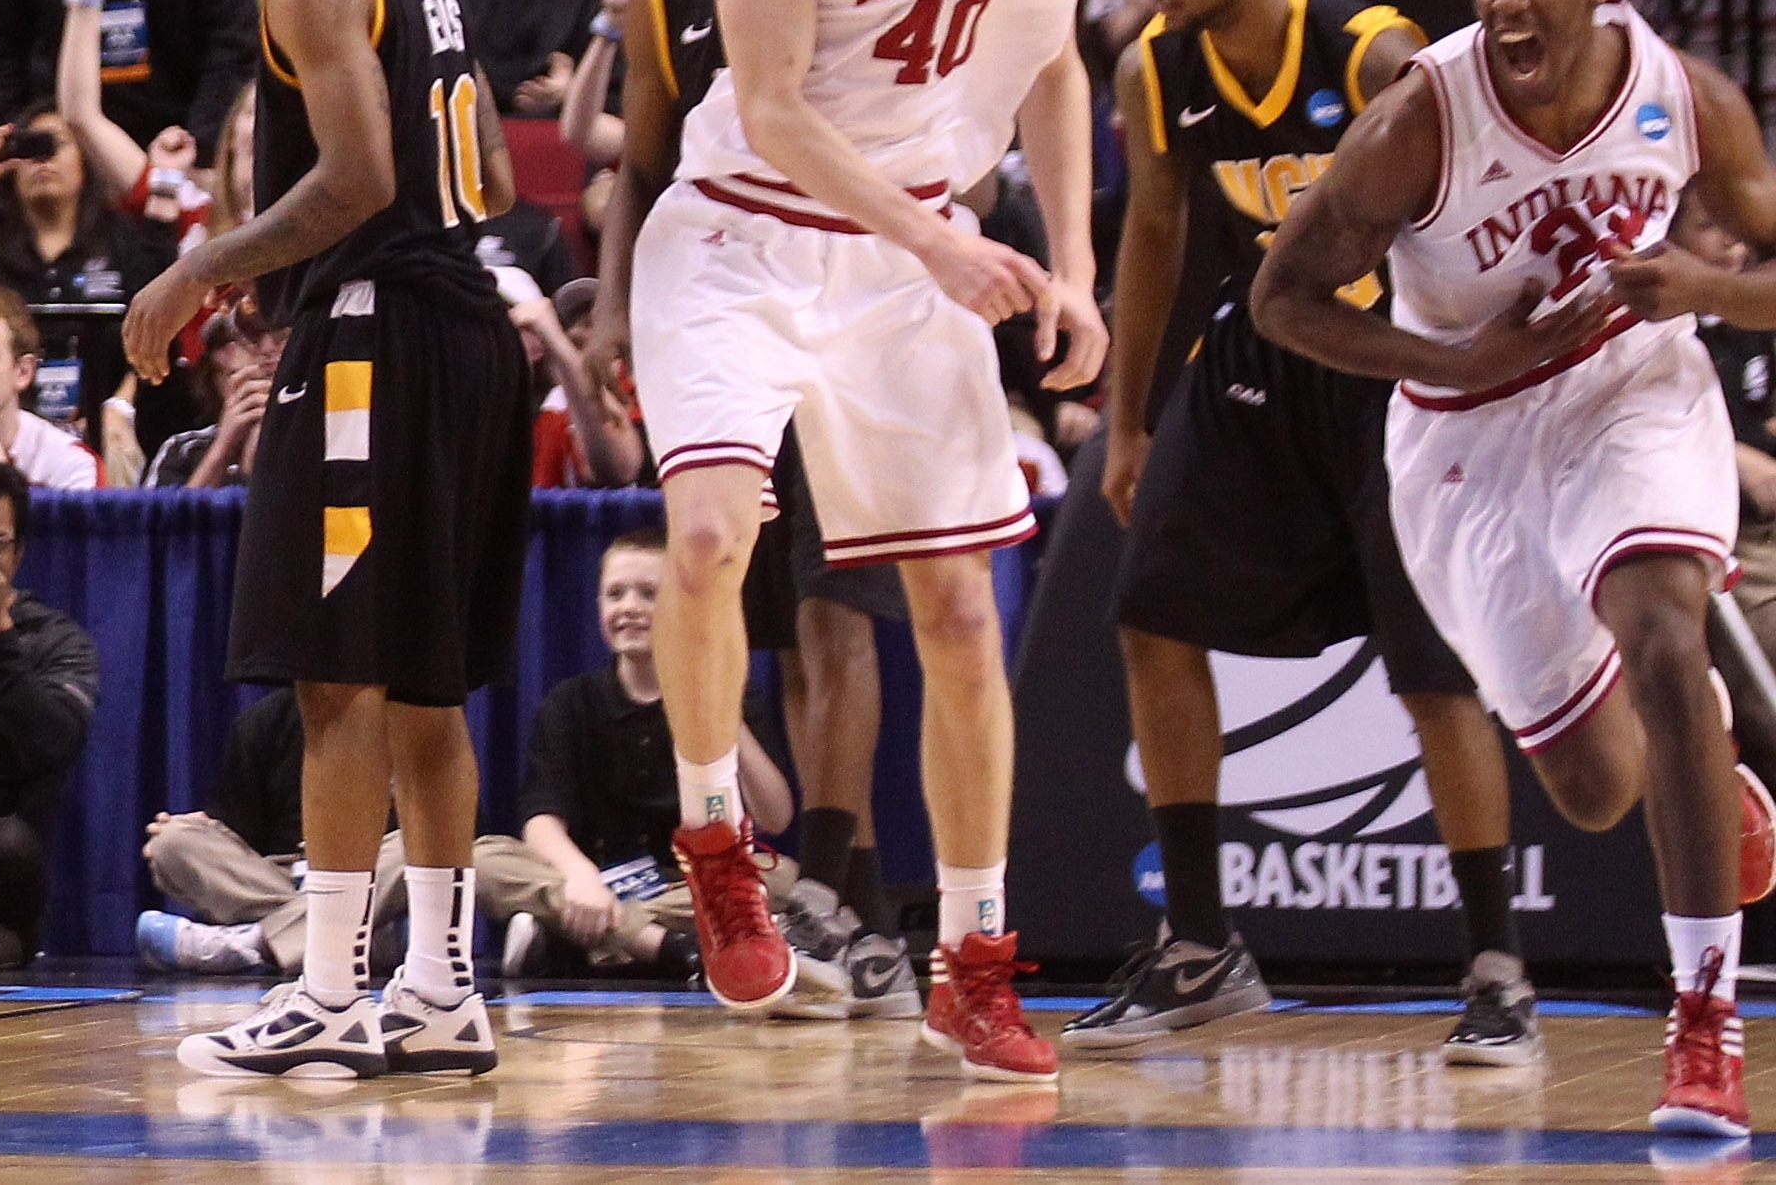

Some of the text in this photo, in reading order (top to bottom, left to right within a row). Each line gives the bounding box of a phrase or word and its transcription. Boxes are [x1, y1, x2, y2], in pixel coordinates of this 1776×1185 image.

[430, 72, 487, 229] 10
[1464, 175, 1667, 273] INDIANA
[1218, 842, 1555, 911] BASKETBL
